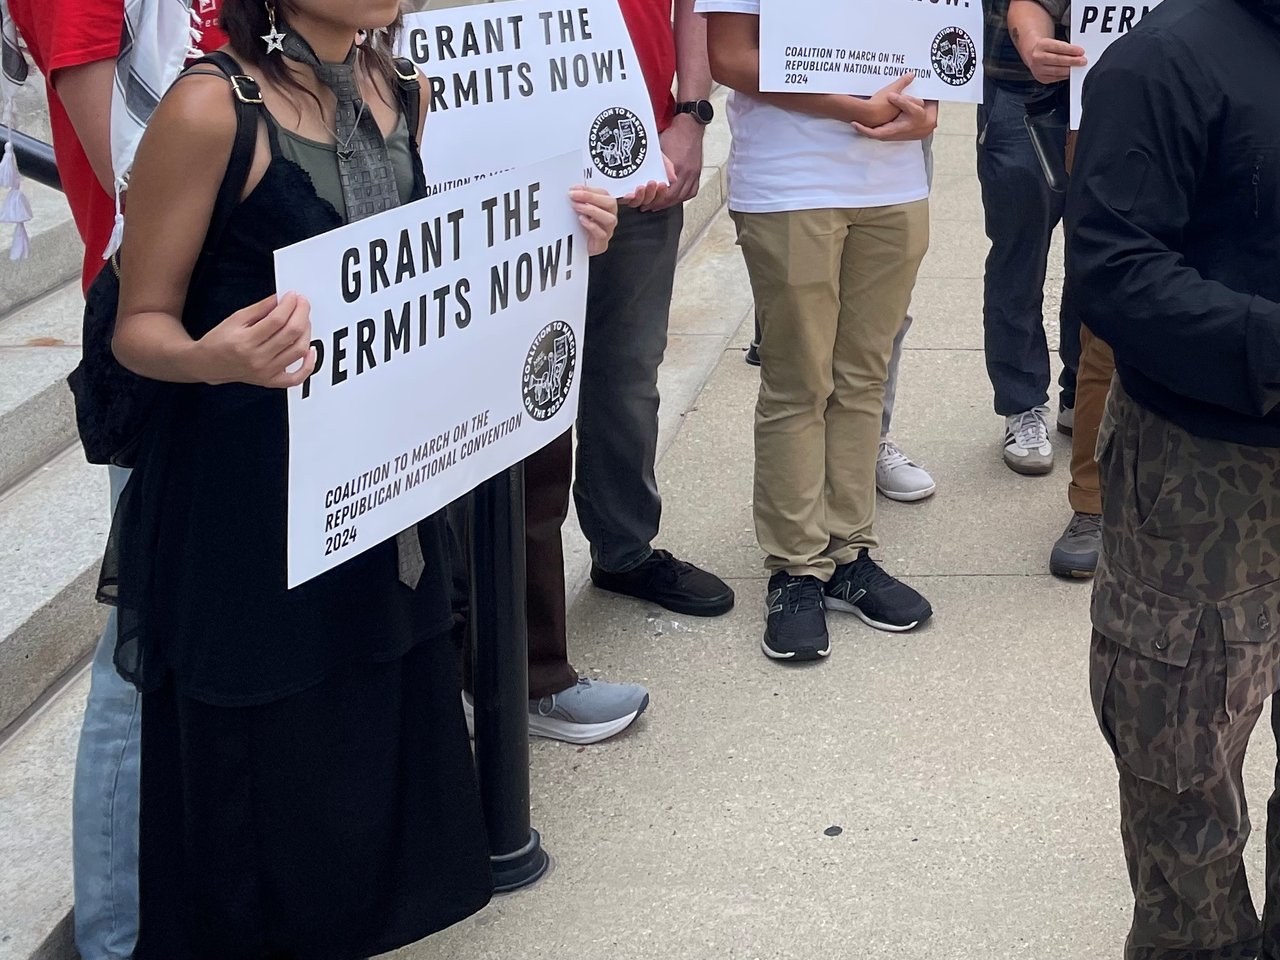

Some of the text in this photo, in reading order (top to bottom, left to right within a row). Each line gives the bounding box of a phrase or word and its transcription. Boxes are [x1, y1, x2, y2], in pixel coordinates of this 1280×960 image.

[409, 7, 592, 64] GRANT THE
[785, 46, 905, 65] COALITION TO MARCH ON THE
[785, 60, 841, 73] REPUBLICAN
[843, 63, 882, 76] NATIONAL
[427, 48, 627, 113] RMITS NOW!
[785, 73, 808, 85] 2024
[590, 108, 614, 147] COALITION
[614, 108, 625, 116] TO
[626, 111, 645, 137] MARCH
[426, 176, 471, 197] OALITION
[594, 157, 604, 169] ON
[603, 166, 617, 177] THE
[341, 182, 541, 304] GRANT THE
[302, 234, 573, 400] PERMITS NOW!
[523, 324, 553, 383] COALITION
[553, 321, 562, 331] TO
[562, 324, 575, 357] MARCH
[524, 396, 534, 412] ON
[533, 407, 546, 419] THE
[325, 409, 490, 509] COALITION TO MARCH ON THE
[325, 411, 523, 533] REPUBLICAN NATIONAL CONVENTION
[325, 525, 357, 557] 2024
